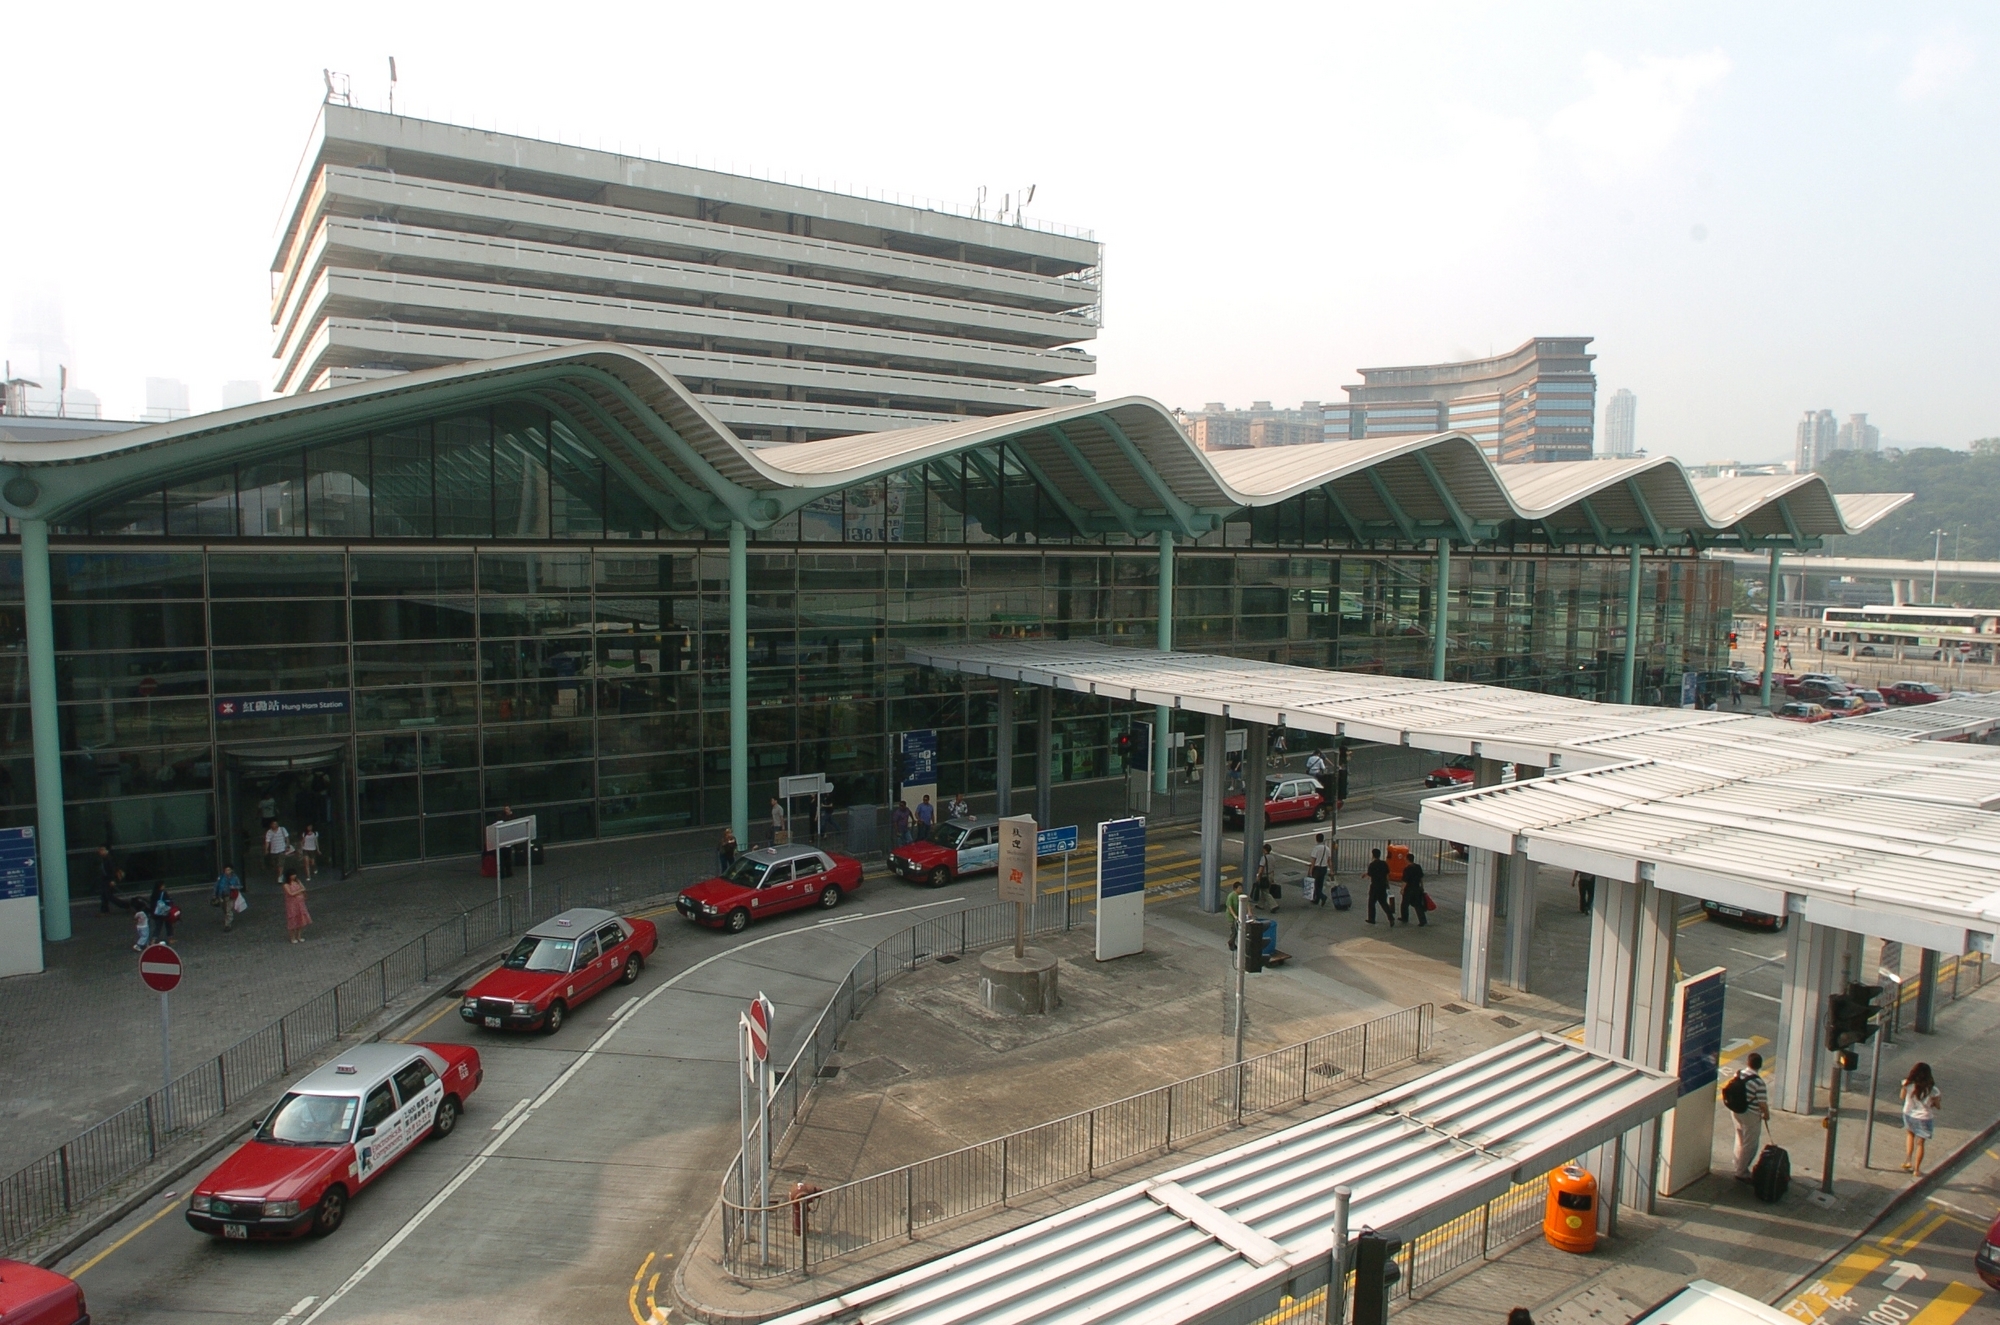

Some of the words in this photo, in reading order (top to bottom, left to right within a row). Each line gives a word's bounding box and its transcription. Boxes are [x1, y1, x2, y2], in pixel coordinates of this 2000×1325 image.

[281, 704, 301, 712] Hung
[301, 702, 318, 710] Hom
[319, 701, 343, 709] Station
